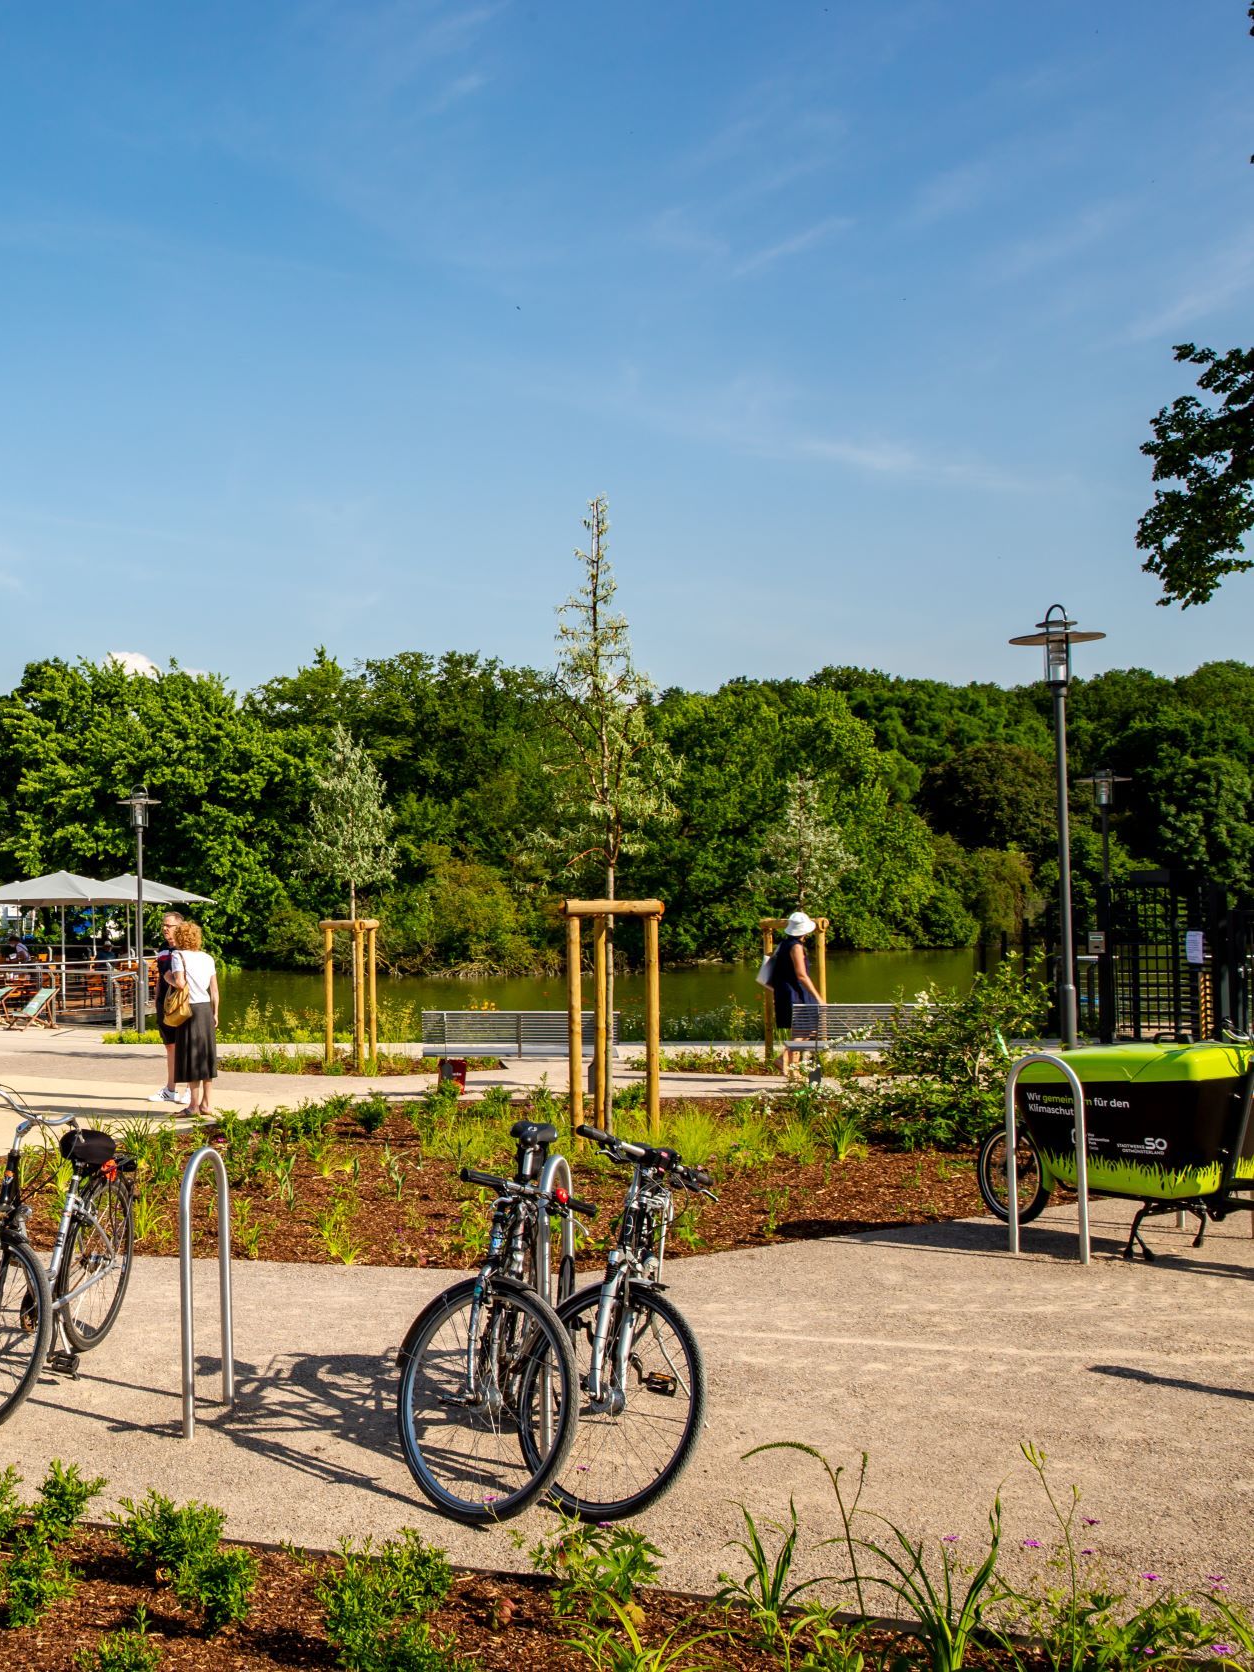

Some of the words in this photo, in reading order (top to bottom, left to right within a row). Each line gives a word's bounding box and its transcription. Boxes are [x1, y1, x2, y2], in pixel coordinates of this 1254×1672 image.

[1026, 1092, 1041, 1101] Wir
[1042, 1094, 1092, 1105] gemeinm
[1093, 1097, 1108, 1107] für
[1110, 1098, 1130, 1109] den
[1028, 1103, 1075, 1116] Klimaschut
